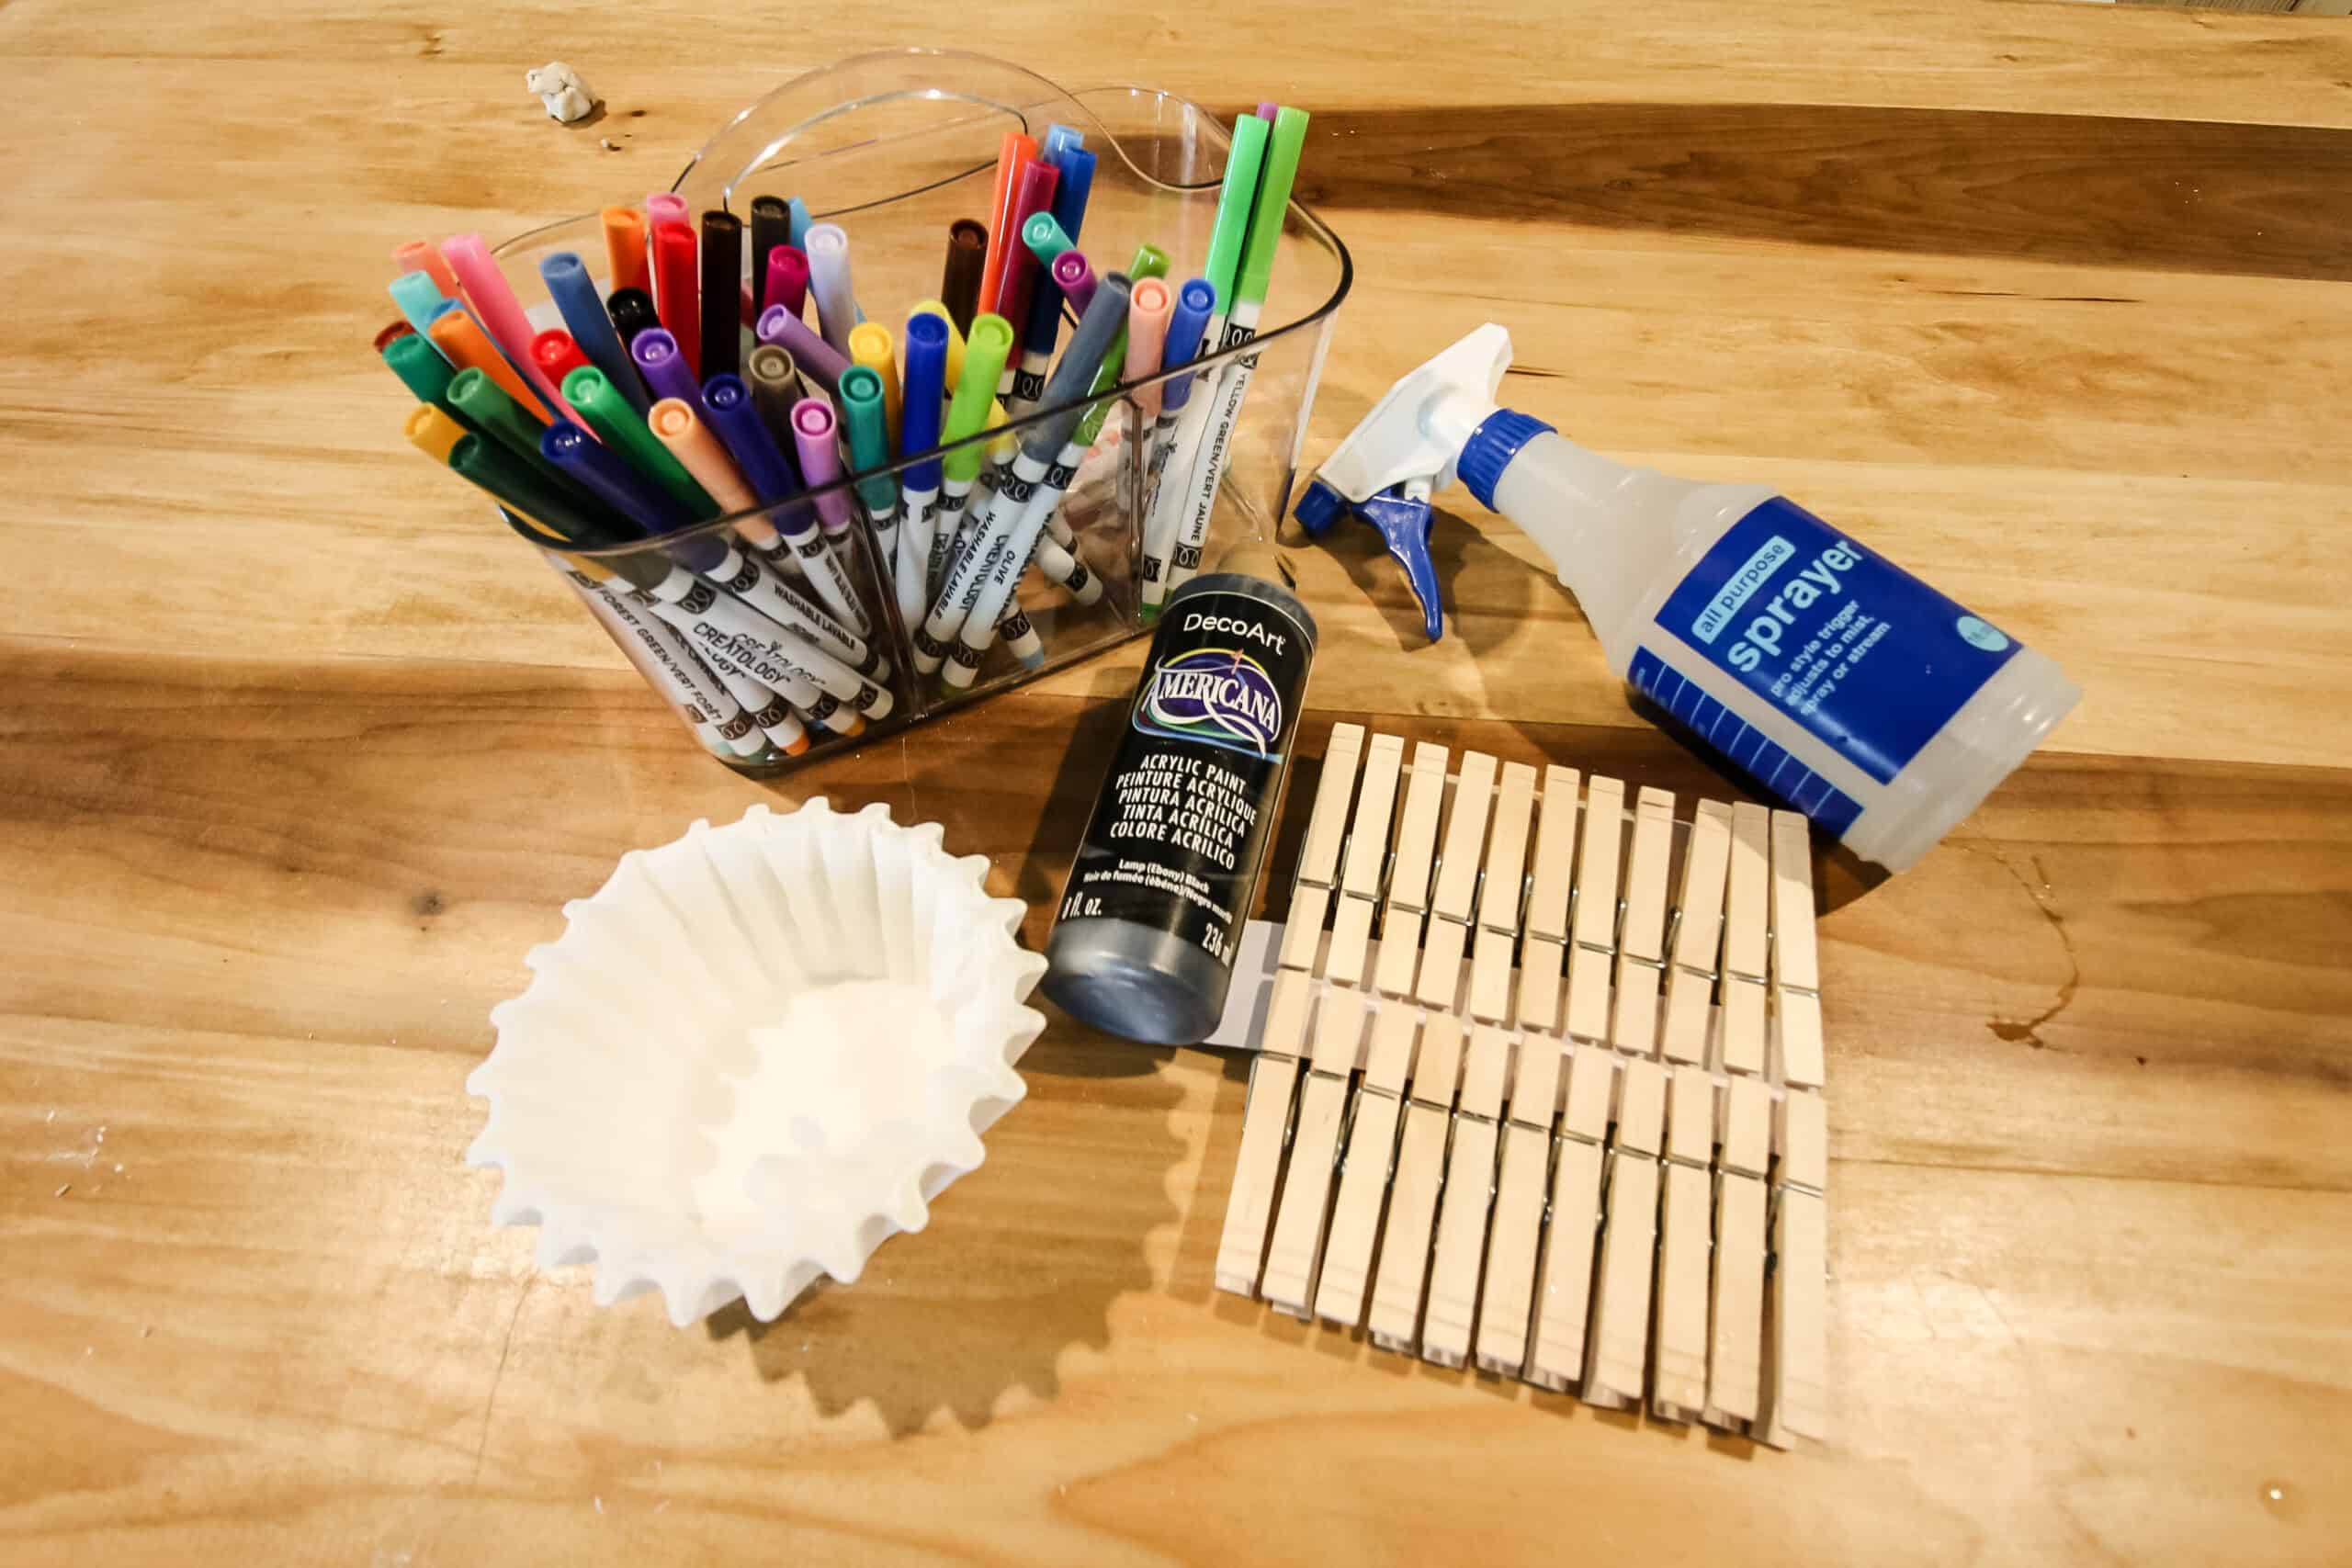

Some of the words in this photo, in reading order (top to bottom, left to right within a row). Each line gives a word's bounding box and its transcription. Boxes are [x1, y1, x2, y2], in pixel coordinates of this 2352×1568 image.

[1226, 372, 1247, 418] YELLOW
[1203, 420, 1229, 498] GREEN/VERT
[961, 511, 996, 572] WASHABLE
[1191, 501, 1206, 542] JAUNE
[994, 550, 1015, 586] OLIVE
[1702, 604, 1722, 633] all
[1721, 545, 1784, 610] purpose
[933, 570, 964, 619] LAVABLE
[1727, 539, 1863, 672] sprayer
[599, 588, 640, 626] FOREST
[637, 628, 696, 689] GREEN/VERT
[1182, 613, 1286, 656] DecoArt
[1771, 672, 1792, 698] pro
[1790, 640, 1821, 671] style
[1817, 599, 1860, 639] trigger
[1785, 659, 1828, 705] adjusts
[1824, 643, 1843, 658] to
[1800, 679, 1836, 716] spray
[1832, 662, 1849, 680] or
[1847, 622, 1892, 663] stream
[1141, 667, 1276, 734] AMERICANA
[1115, 770, 1183, 791] PEINTURE
[1186, 776, 1258, 826] ACRYLIQUE
[1118, 787, 1180, 807] PINTURA
[1139, 754, 1202, 776] ACRYLIC
[1205, 763, 1247, 795] PAINT
[1123, 804, 1163, 822] TINTA
[1110, 820, 1168, 841] COLORE
[1170, 828, 1236, 871] ACRILICO
[1101, 870, 1112, 882] de
[1118, 857, 1147, 873] Lamp
[1147, 862, 1185, 883] (Ebony)
[1185, 874, 1210, 895] Black
[1085, 897, 1102, 916] oz.
[1202, 922, 1224, 957] 236
